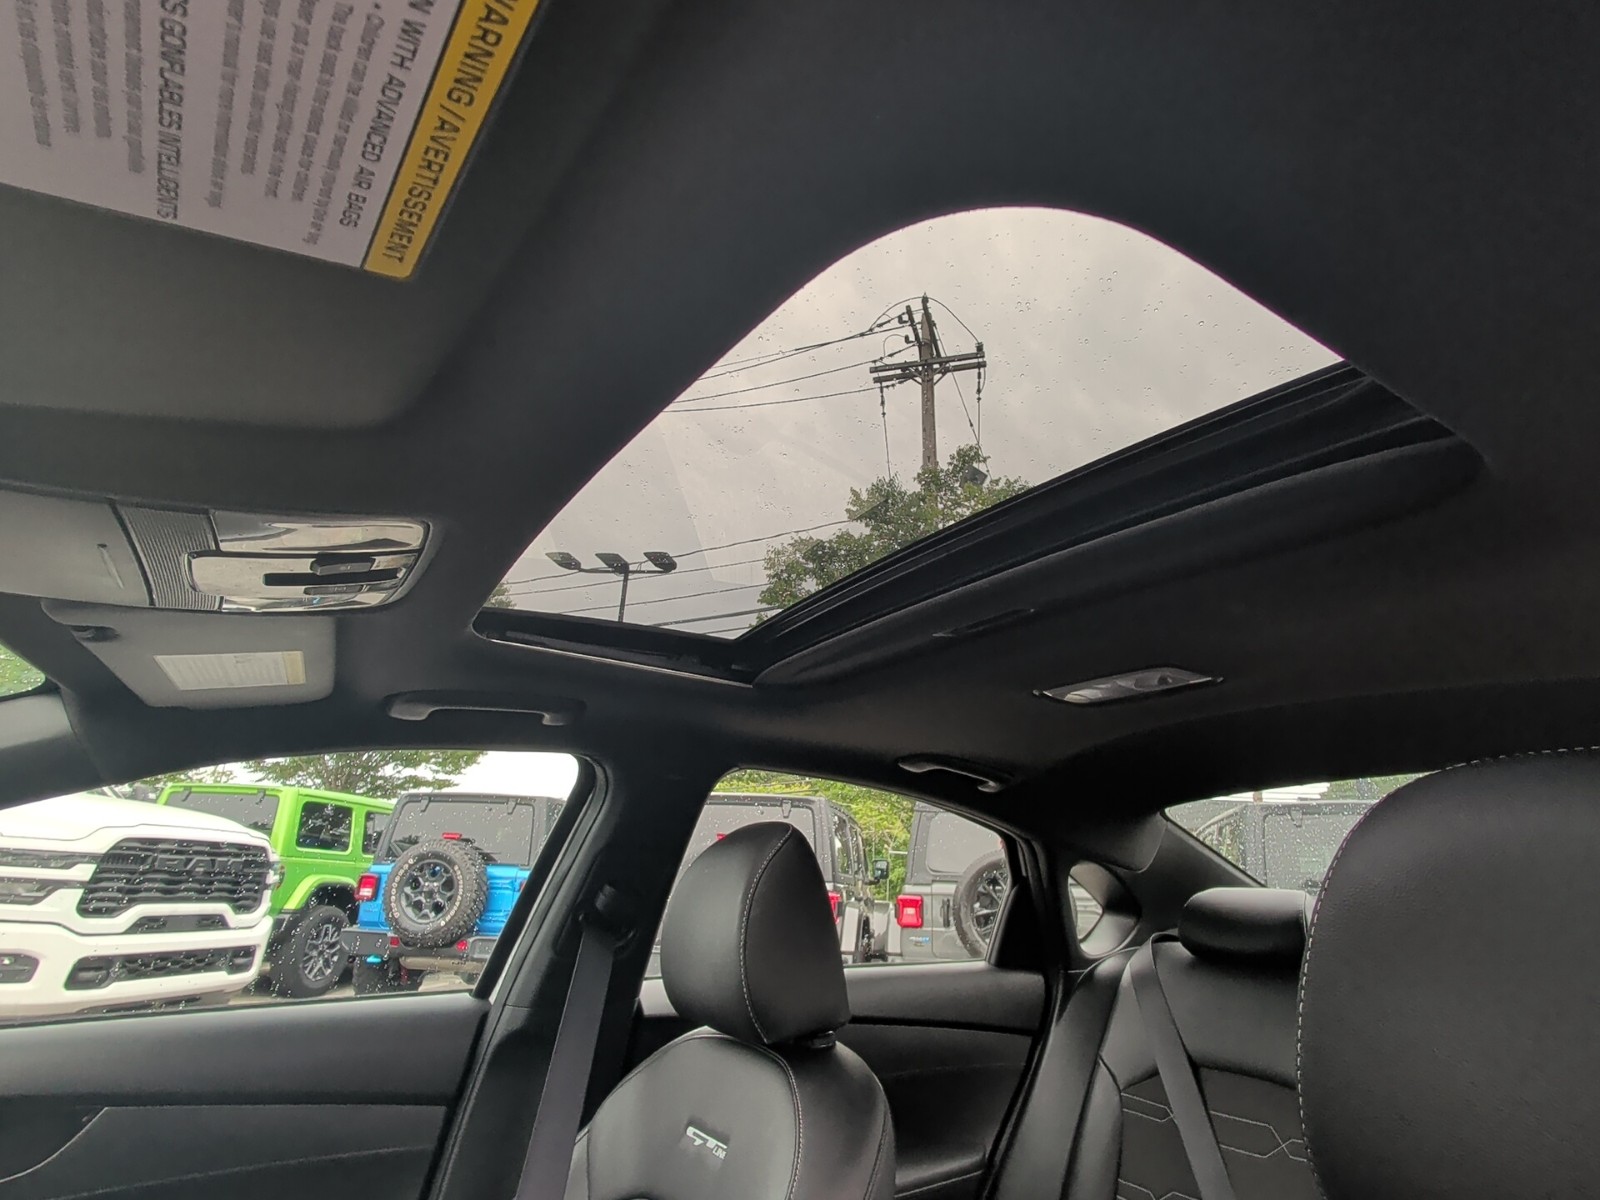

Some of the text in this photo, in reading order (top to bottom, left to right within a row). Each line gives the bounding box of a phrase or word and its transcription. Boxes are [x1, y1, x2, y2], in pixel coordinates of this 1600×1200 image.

[390, 19, 427, 71] WITH
[361, 73, 406, 163] ADVANCED
[352, 163, 376, 190] AIR
[339, 191, 368, 229] BAGS
